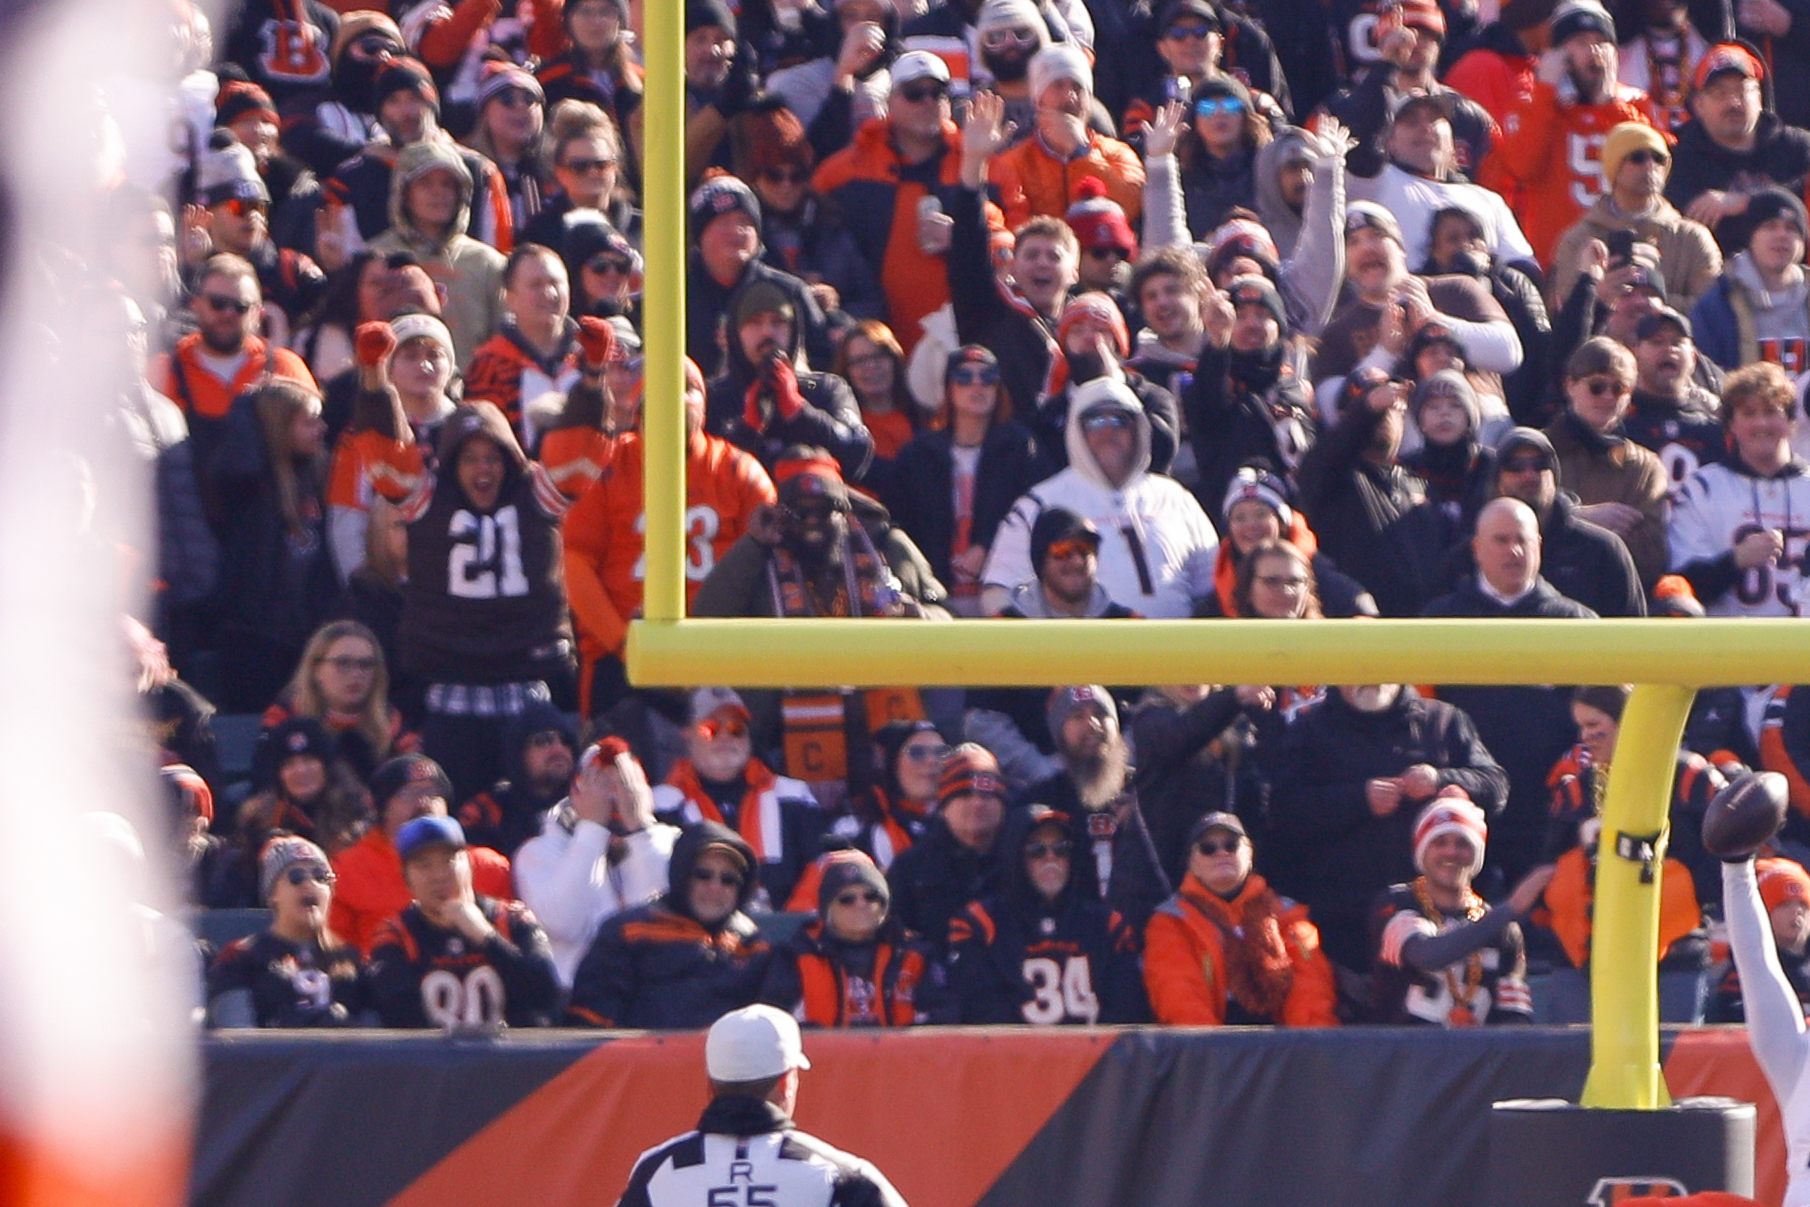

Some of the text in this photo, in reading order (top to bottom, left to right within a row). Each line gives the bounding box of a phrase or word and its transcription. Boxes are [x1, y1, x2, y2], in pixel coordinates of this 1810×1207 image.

[447, 504, 528, 599] 21
[1021, 955, 1099, 1024] 34
[730, 1161, 753, 1184] R
